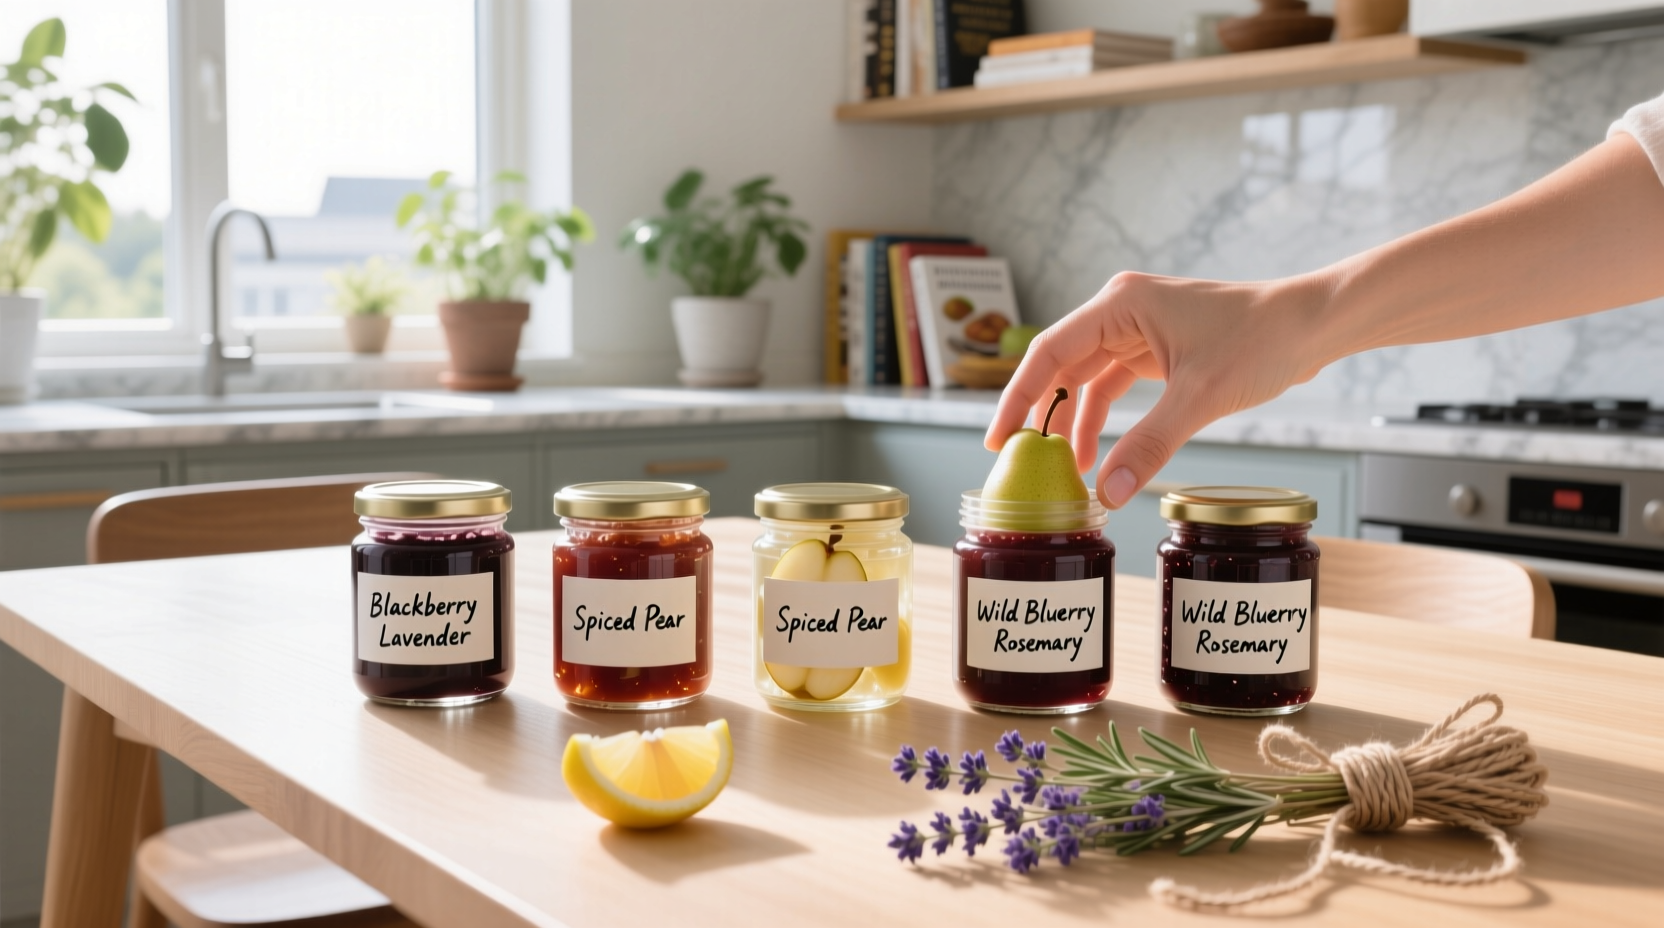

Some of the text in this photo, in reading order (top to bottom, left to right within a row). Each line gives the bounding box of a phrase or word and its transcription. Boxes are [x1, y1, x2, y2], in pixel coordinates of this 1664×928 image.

[369, 591, 478, 625] Blackberry
[573, 603, 686, 642] Spiced Pear
[775, 604, 888, 644] Spiced Pear
[977, 598, 1096, 633] Wild Bluerry
[1181, 598, 1308, 633] Wild Bluerry
[379, 622, 472, 648] Lavender
[993, 628, 1083, 663] Rosemary
[1195, 629, 1288, 665] Rosemary
